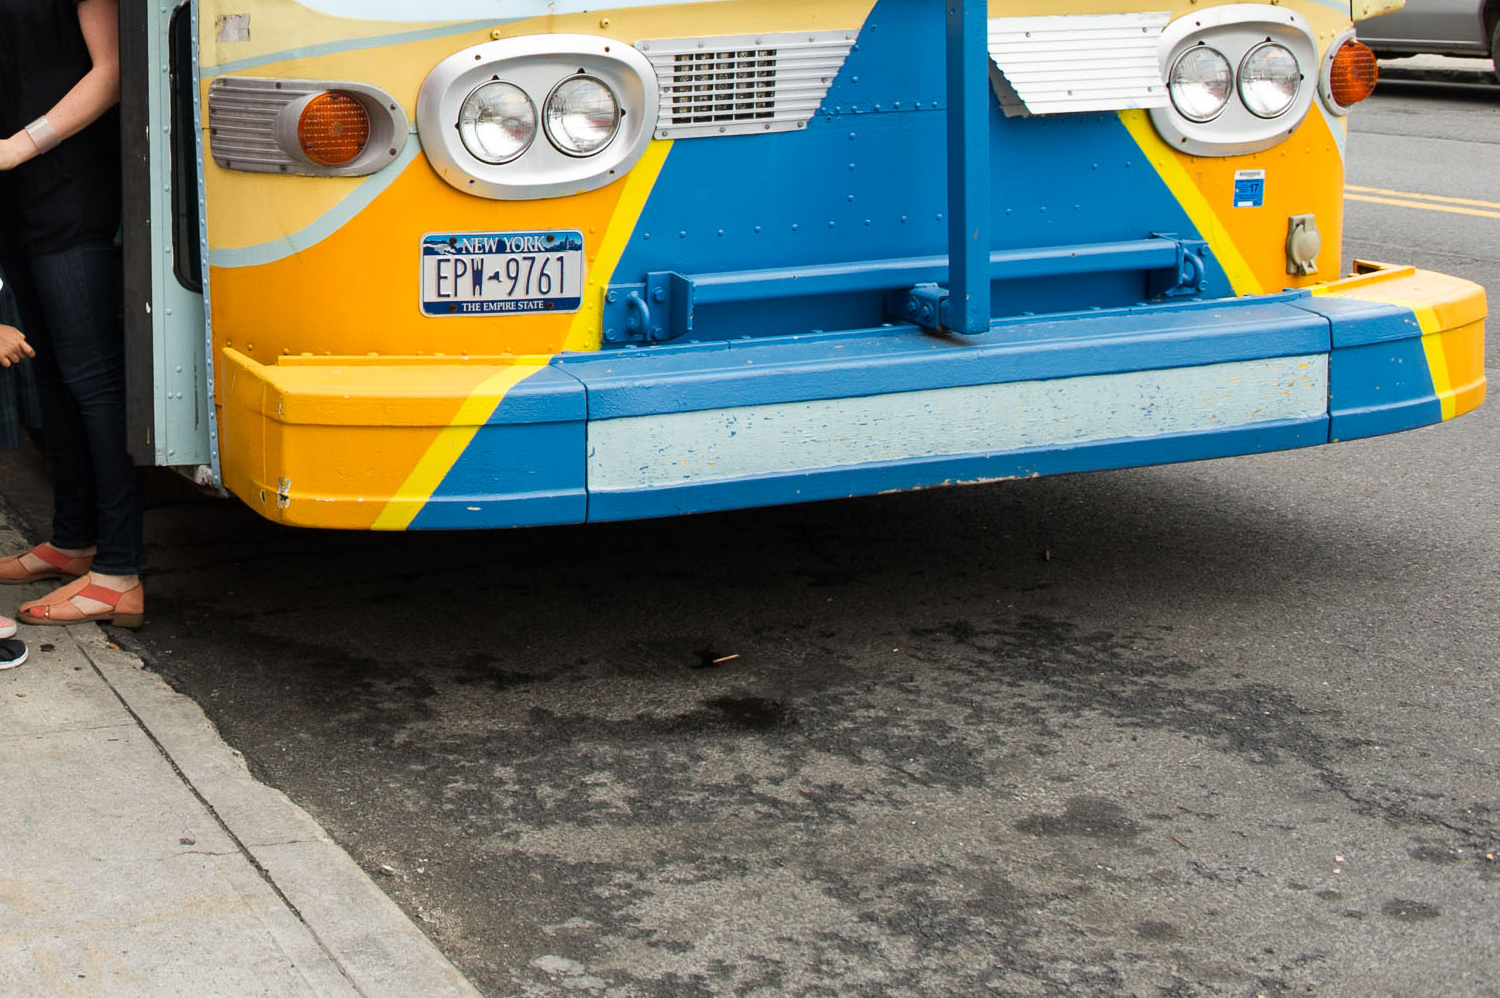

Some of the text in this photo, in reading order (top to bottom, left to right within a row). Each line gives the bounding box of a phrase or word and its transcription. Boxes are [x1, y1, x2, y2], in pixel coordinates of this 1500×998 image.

[1250, 183, 1260, 193] 17
[462, 235, 546, 253] NEW YORK
[437, 255, 565, 297] EPW 9761
[462, 301, 544, 312] THE EMPIRE STATE
